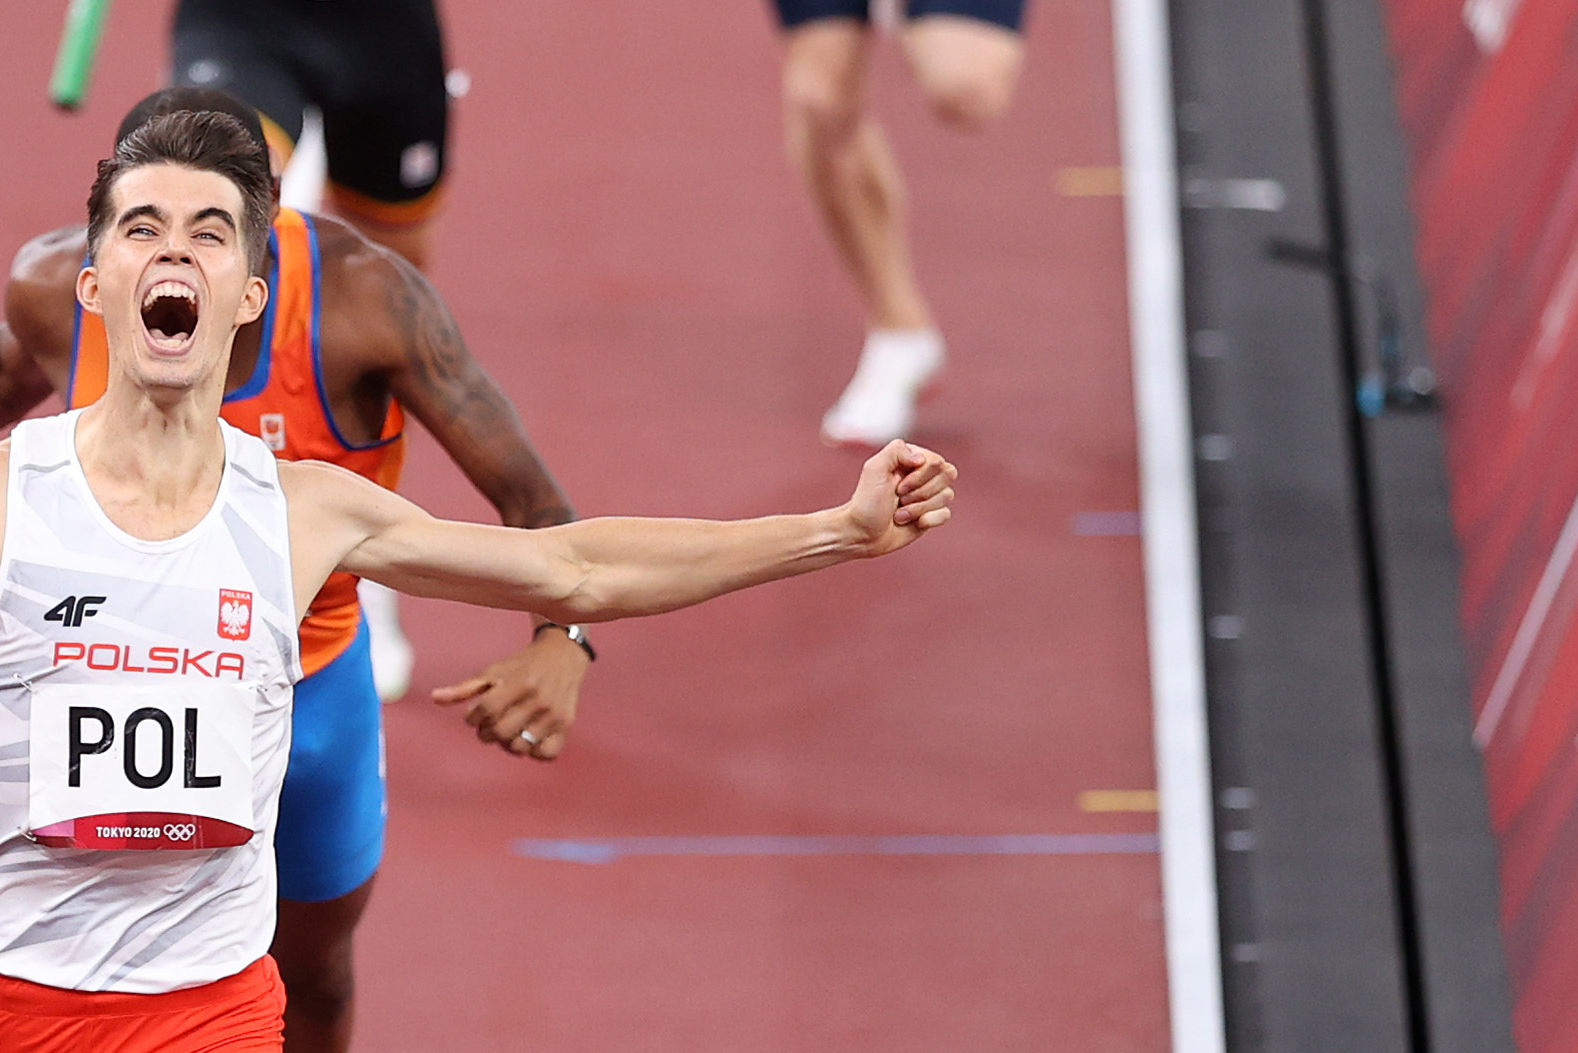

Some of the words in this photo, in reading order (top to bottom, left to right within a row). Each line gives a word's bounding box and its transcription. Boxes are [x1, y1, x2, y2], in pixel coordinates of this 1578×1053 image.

[43, 595, 107, 628] 4F
[220, 590, 251, 600] POLSKA
[52, 642, 245, 680] POLSKA
[68, 706, 222, 790] POL
[96, 826, 132, 838] TOKYO
[133, 827, 161, 838] 2020
